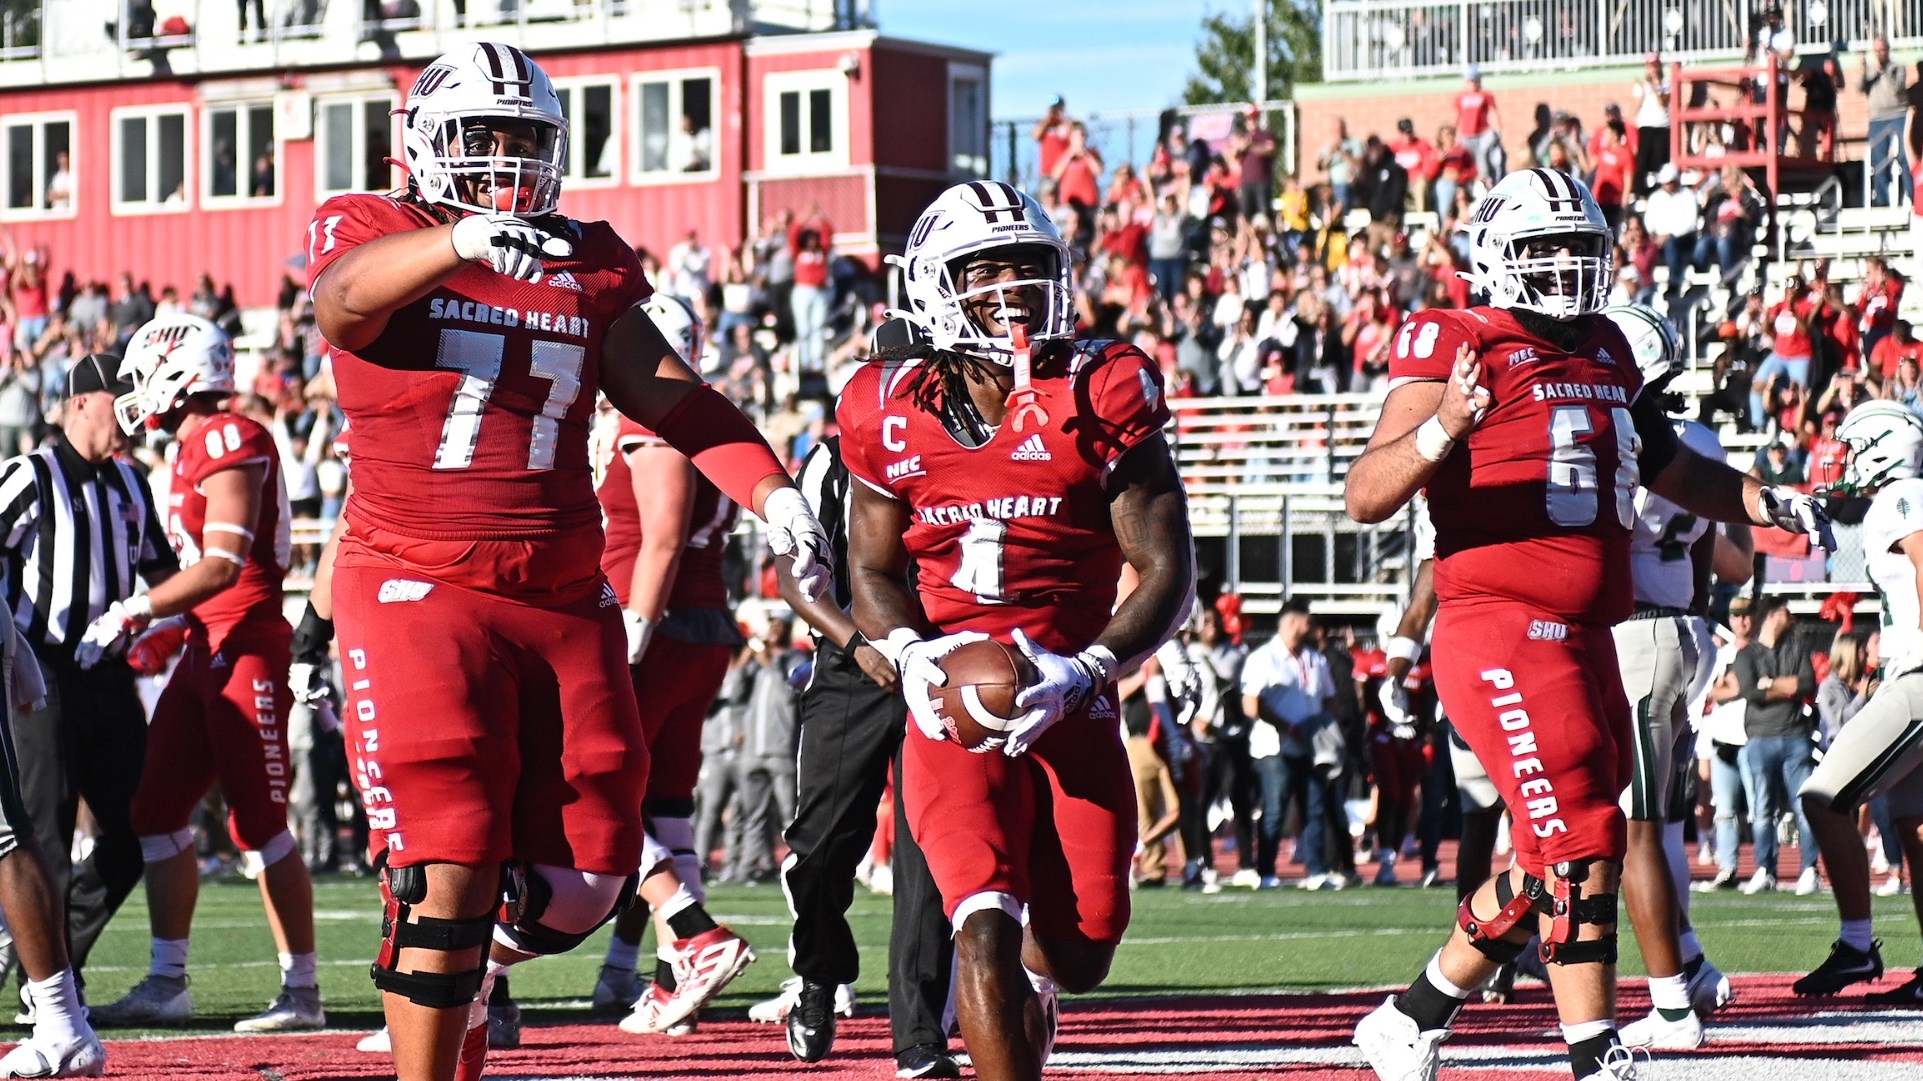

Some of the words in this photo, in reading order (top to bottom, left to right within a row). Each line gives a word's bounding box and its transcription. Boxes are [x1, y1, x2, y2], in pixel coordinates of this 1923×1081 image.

[991, 224, 1029, 233] PIONEERS
[428, 298, 519, 328] SACRED
[524, 310, 590, 339] HEART
[431, 328, 587, 471] 77
[1533, 382, 1593, 402] SACRED
[1593, 384, 1627, 404] HEAR
[881, 415, 908, 453] C
[886, 454, 922, 479] NEC
[1011, 449, 1052, 462] adidas
[1545, 405, 1644, 531] 68
[986, 495, 1063, 520] HEART
[1528, 619, 1568, 641] SHU
[251, 677, 288, 804] PIONEERS
[1480, 668, 1567, 839] PIONEERS
